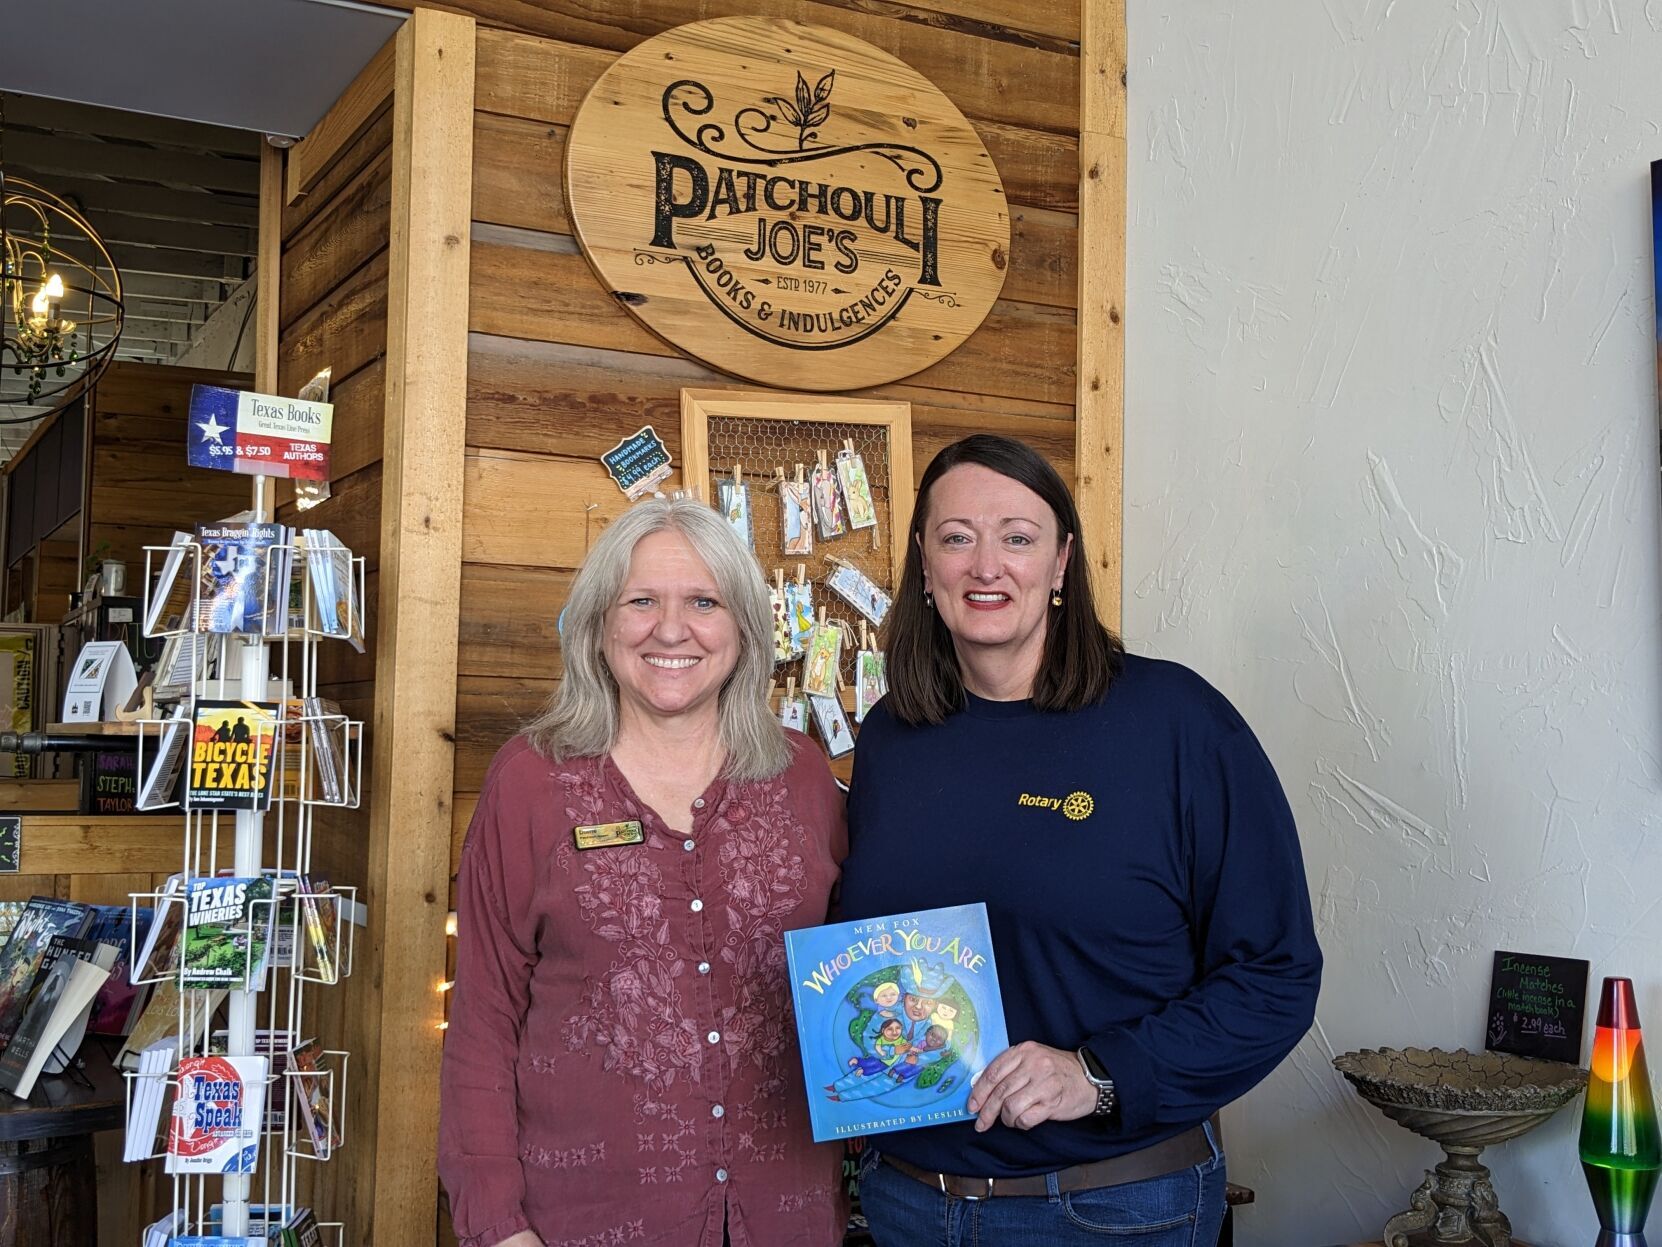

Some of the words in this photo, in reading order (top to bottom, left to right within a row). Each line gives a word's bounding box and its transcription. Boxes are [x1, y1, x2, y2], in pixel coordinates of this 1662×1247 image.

[649, 151, 943, 287] PATCHOULI
[744, 218, 859, 275] JOE'S
[696, 243, 756, 310] BOOKS
[757, 301, 773, 321] &
[778, 268, 902, 333] INDULGENCES
[777, 276, 799, 292] ESTD
[803, 280, 828, 294] 1977
[251, 399, 283, 419] Texas
[287, 404, 321, 425] Books
[209, 444, 233, 457] $5.95
[236, 445, 244, 456] &
[245, 444, 271, 457] $7.50
[283, 451, 323, 461] AUTHORS
[290, 443, 317, 452] TEXAS
[609, 437, 646, 464] HANDMADE
[620, 440, 657, 468] BOOKMARKS
[643, 457, 661, 471] each
[200, 527, 220, 537] Texas
[252, 527, 275, 539] Rights
[193, 742, 271, 764] BICYCLE
[192, 763, 267, 789] TEXAS
[1018, 793, 1062, 810] Rotary
[193, 882, 206, 892] TOP
[190, 883, 247, 913] TEXAS
[189, 905, 244, 926] WINERIES
[854, 923, 885, 934] MEM
[894, 918, 920, 928] FOX
[54, 938, 65, 946] THE
[192, 967, 215, 976] Andrew
[215, 967, 232, 976] Chalk
[803, 934, 903, 994] WHOEVER
[894, 929, 940, 951] YOU
[938, 937, 986, 974] ARE
[1501, 956, 1551, 977] Incense
[1520, 977, 1564, 994] Matches
[1543, 1020, 1566, 1035] each
[194, 1075, 241, 1101] Texas
[194, 1101, 243, 1133] Speak
[836, 1117, 906, 1134] ILLUSTRATED
[910, 1115, 922, 1123] BY
[928, 1109, 964, 1120] LESLIE
